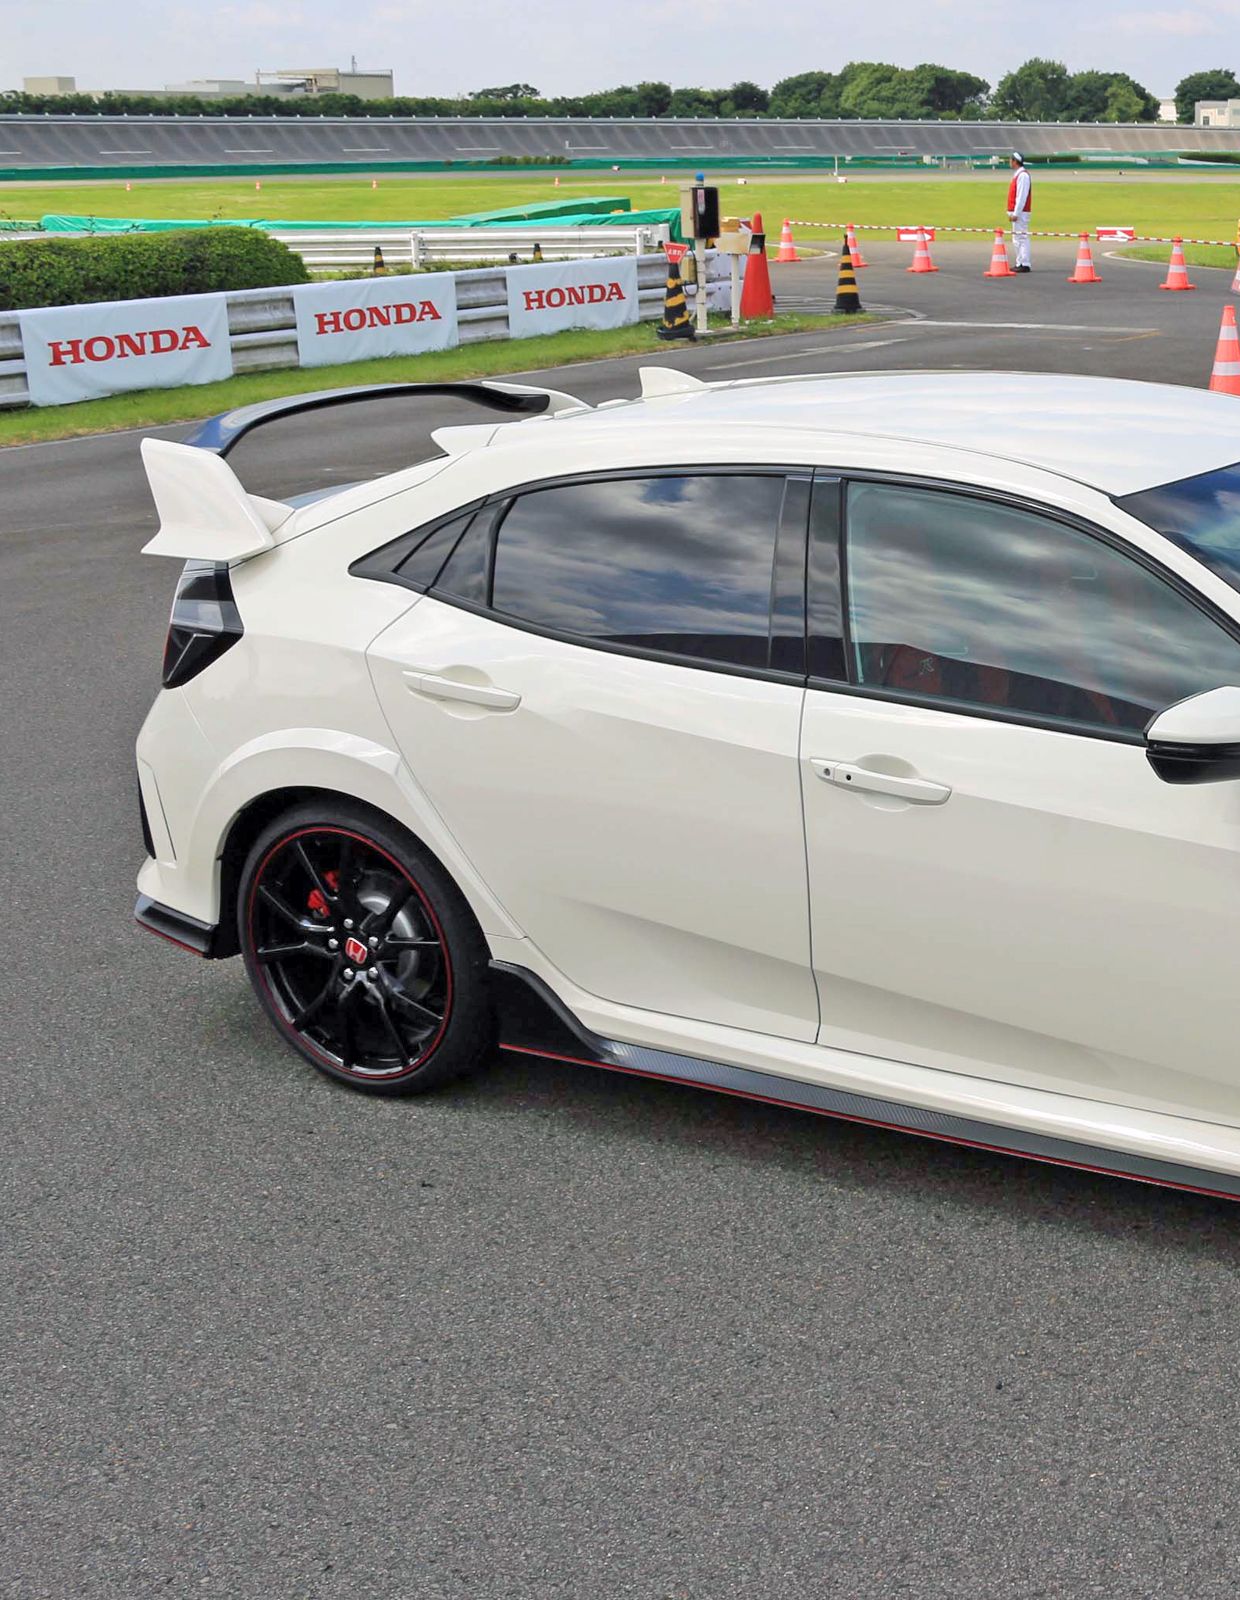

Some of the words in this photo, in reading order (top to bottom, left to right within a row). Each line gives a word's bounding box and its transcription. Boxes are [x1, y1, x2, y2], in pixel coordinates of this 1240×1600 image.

[524, 282, 625, 311] HONDA
[315, 300, 441, 335] HONDA
[48, 326, 210, 366] HONDA
